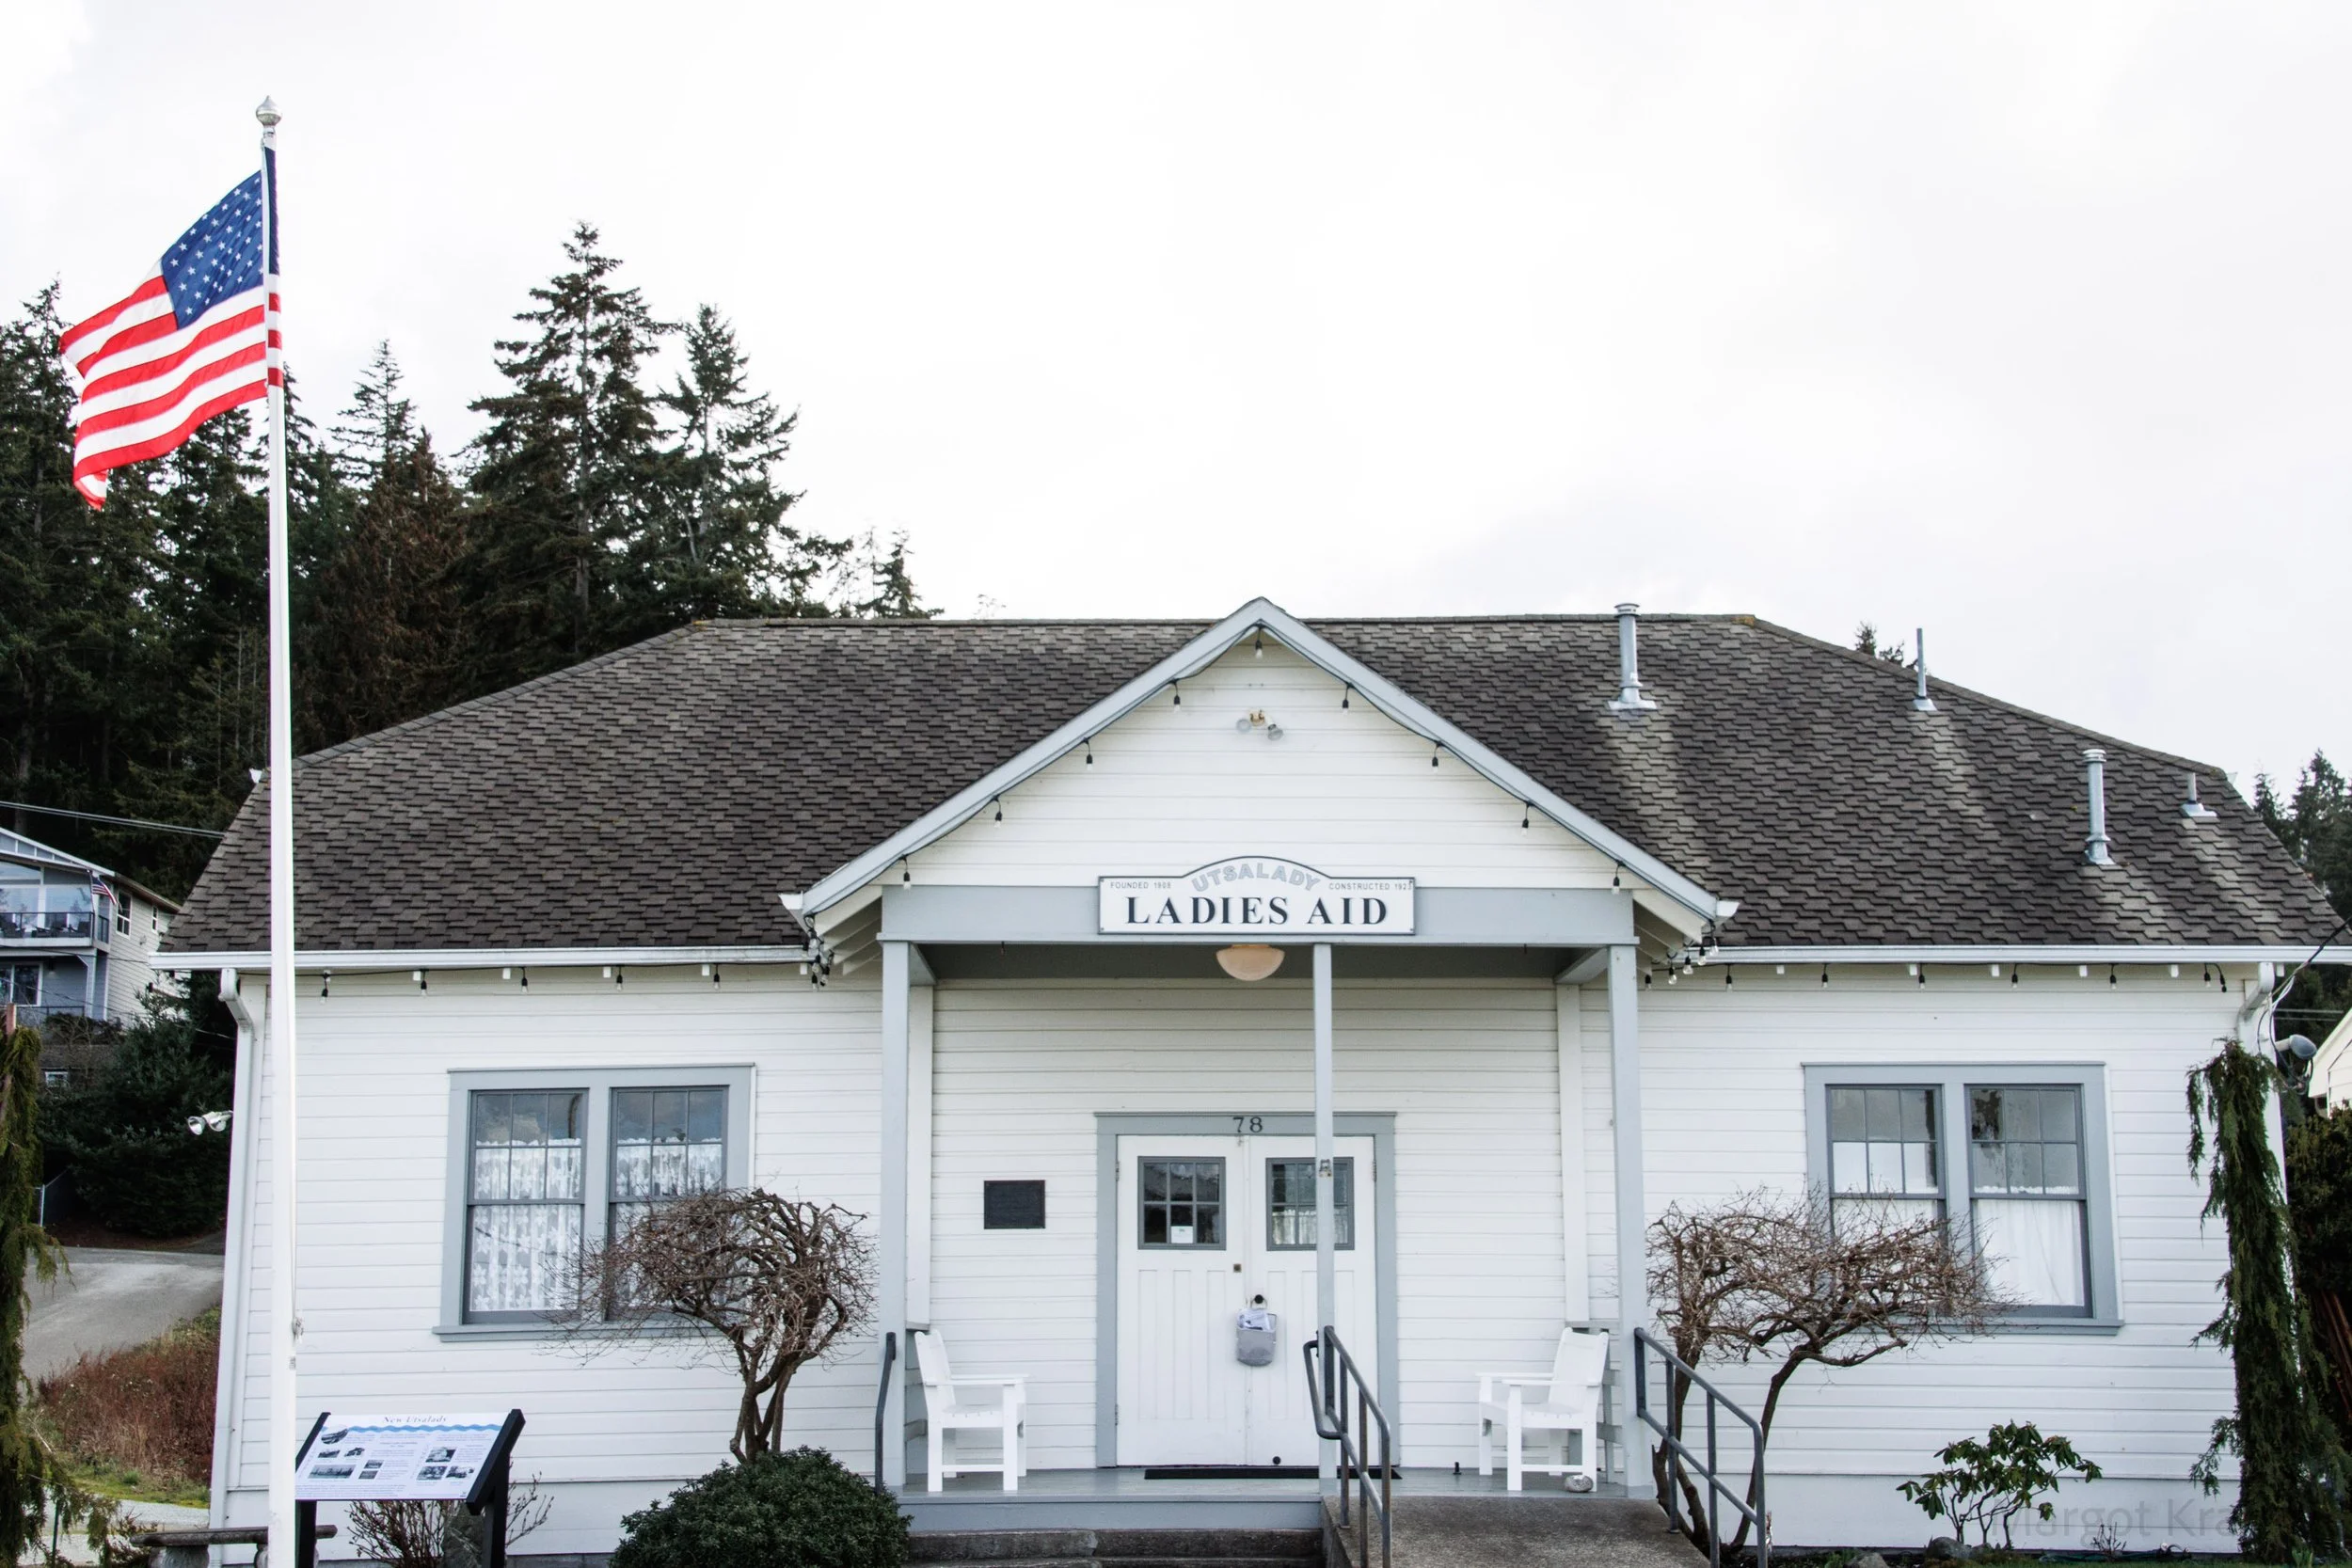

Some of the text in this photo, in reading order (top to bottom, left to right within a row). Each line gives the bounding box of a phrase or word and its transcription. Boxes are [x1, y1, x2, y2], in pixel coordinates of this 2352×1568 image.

[1191, 862, 1320, 893] UTSALADY
[1125, 896, 1388, 925] LADIES AID
[1232, 1117, 1263, 1133] 78
